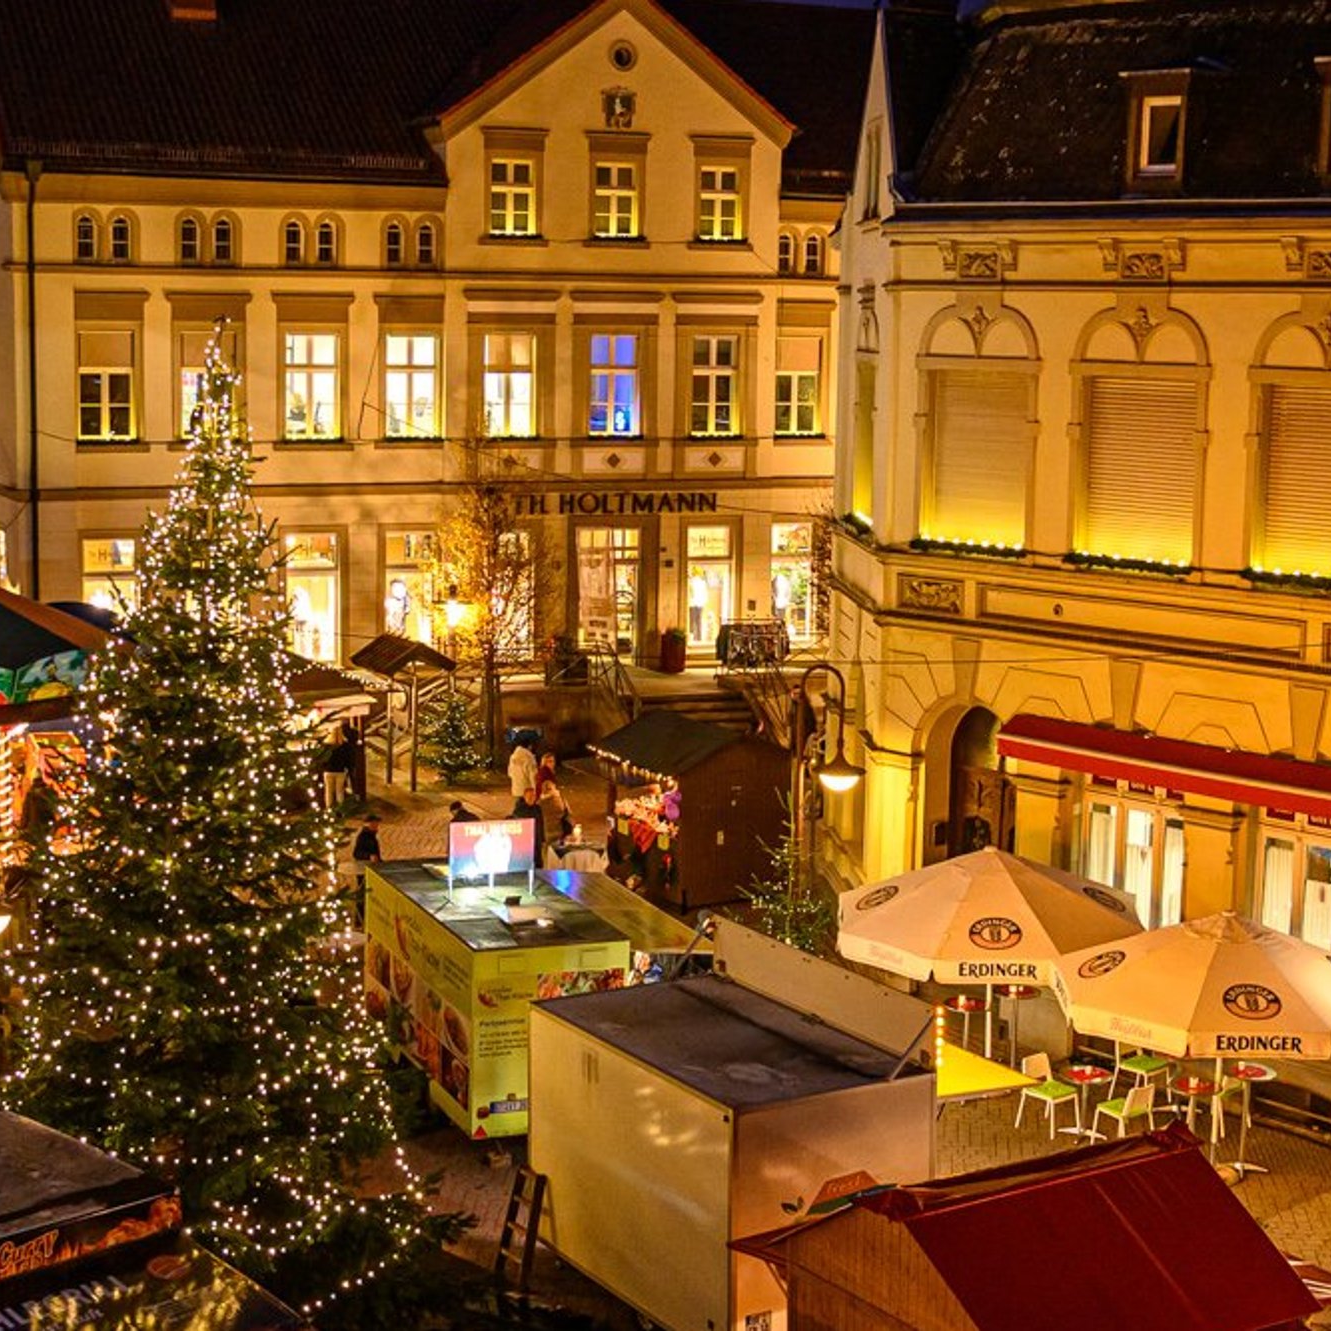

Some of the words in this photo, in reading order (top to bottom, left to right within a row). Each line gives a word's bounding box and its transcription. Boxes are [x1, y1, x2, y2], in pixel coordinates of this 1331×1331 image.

[559, 492, 717, 514] HOLTMANN
[958, 962, 1038, 979] ERDINGER
[1216, 1035, 1303, 1054] ERDINGER
